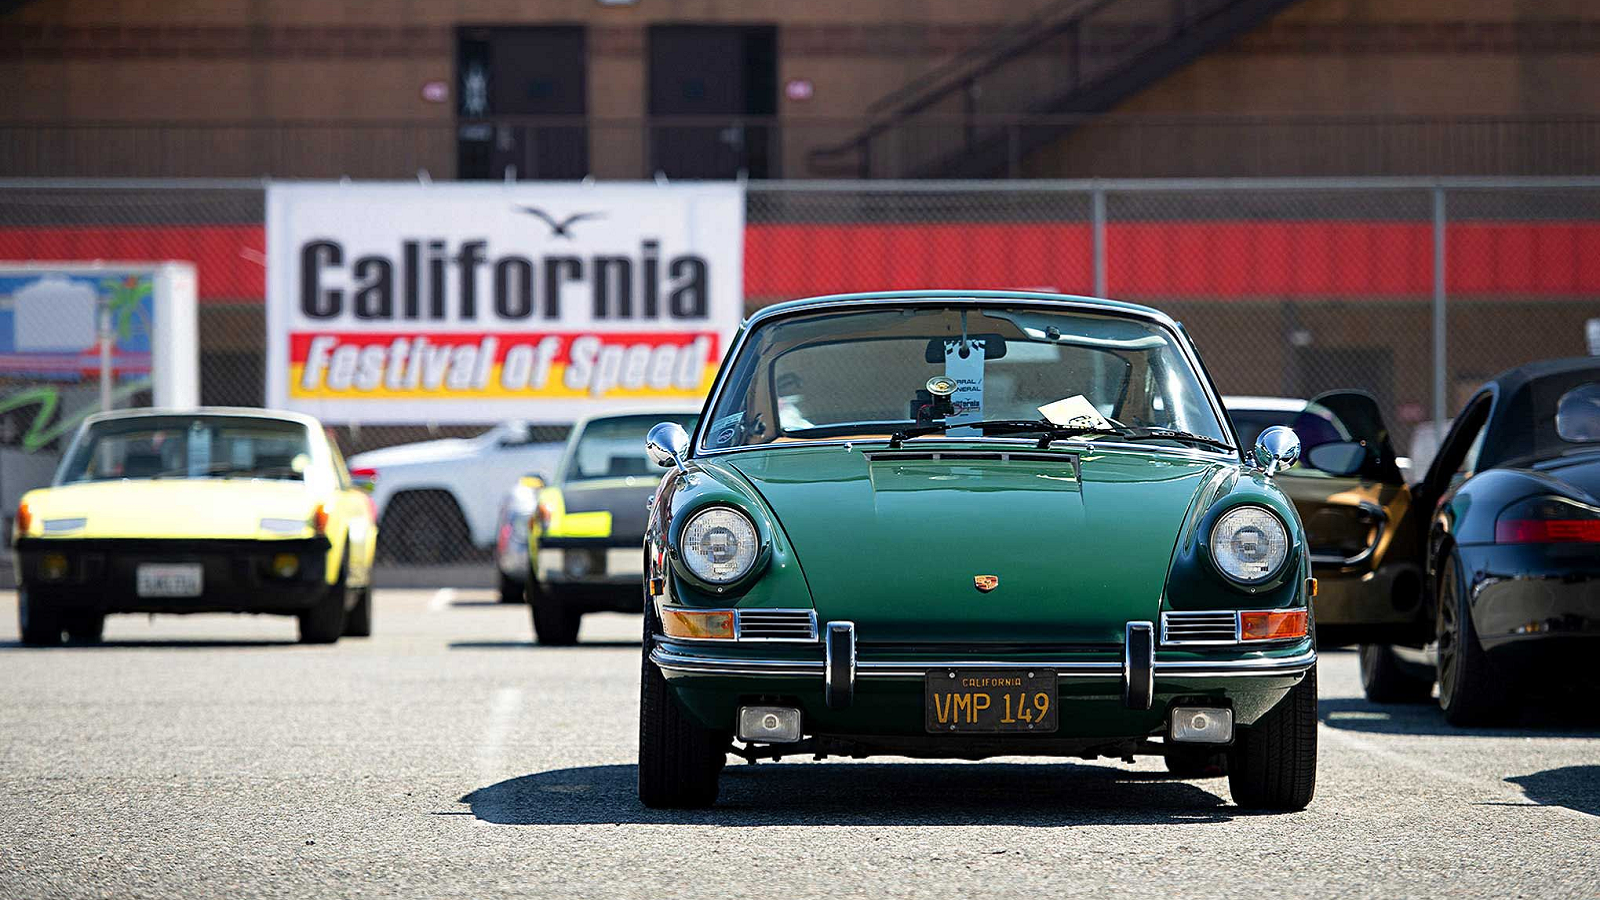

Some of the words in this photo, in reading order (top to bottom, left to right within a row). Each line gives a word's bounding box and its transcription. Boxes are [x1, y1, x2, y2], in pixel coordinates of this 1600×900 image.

[301, 240, 709, 320] California
[303, 336, 497, 391] Festival
[502, 337, 560, 390] of
[565, 336, 711, 397] Speed
[962, 678, 1021, 687] CALIFORNIA
[934, 693, 991, 723] VMP
[1000, 693, 1050, 723] 149
